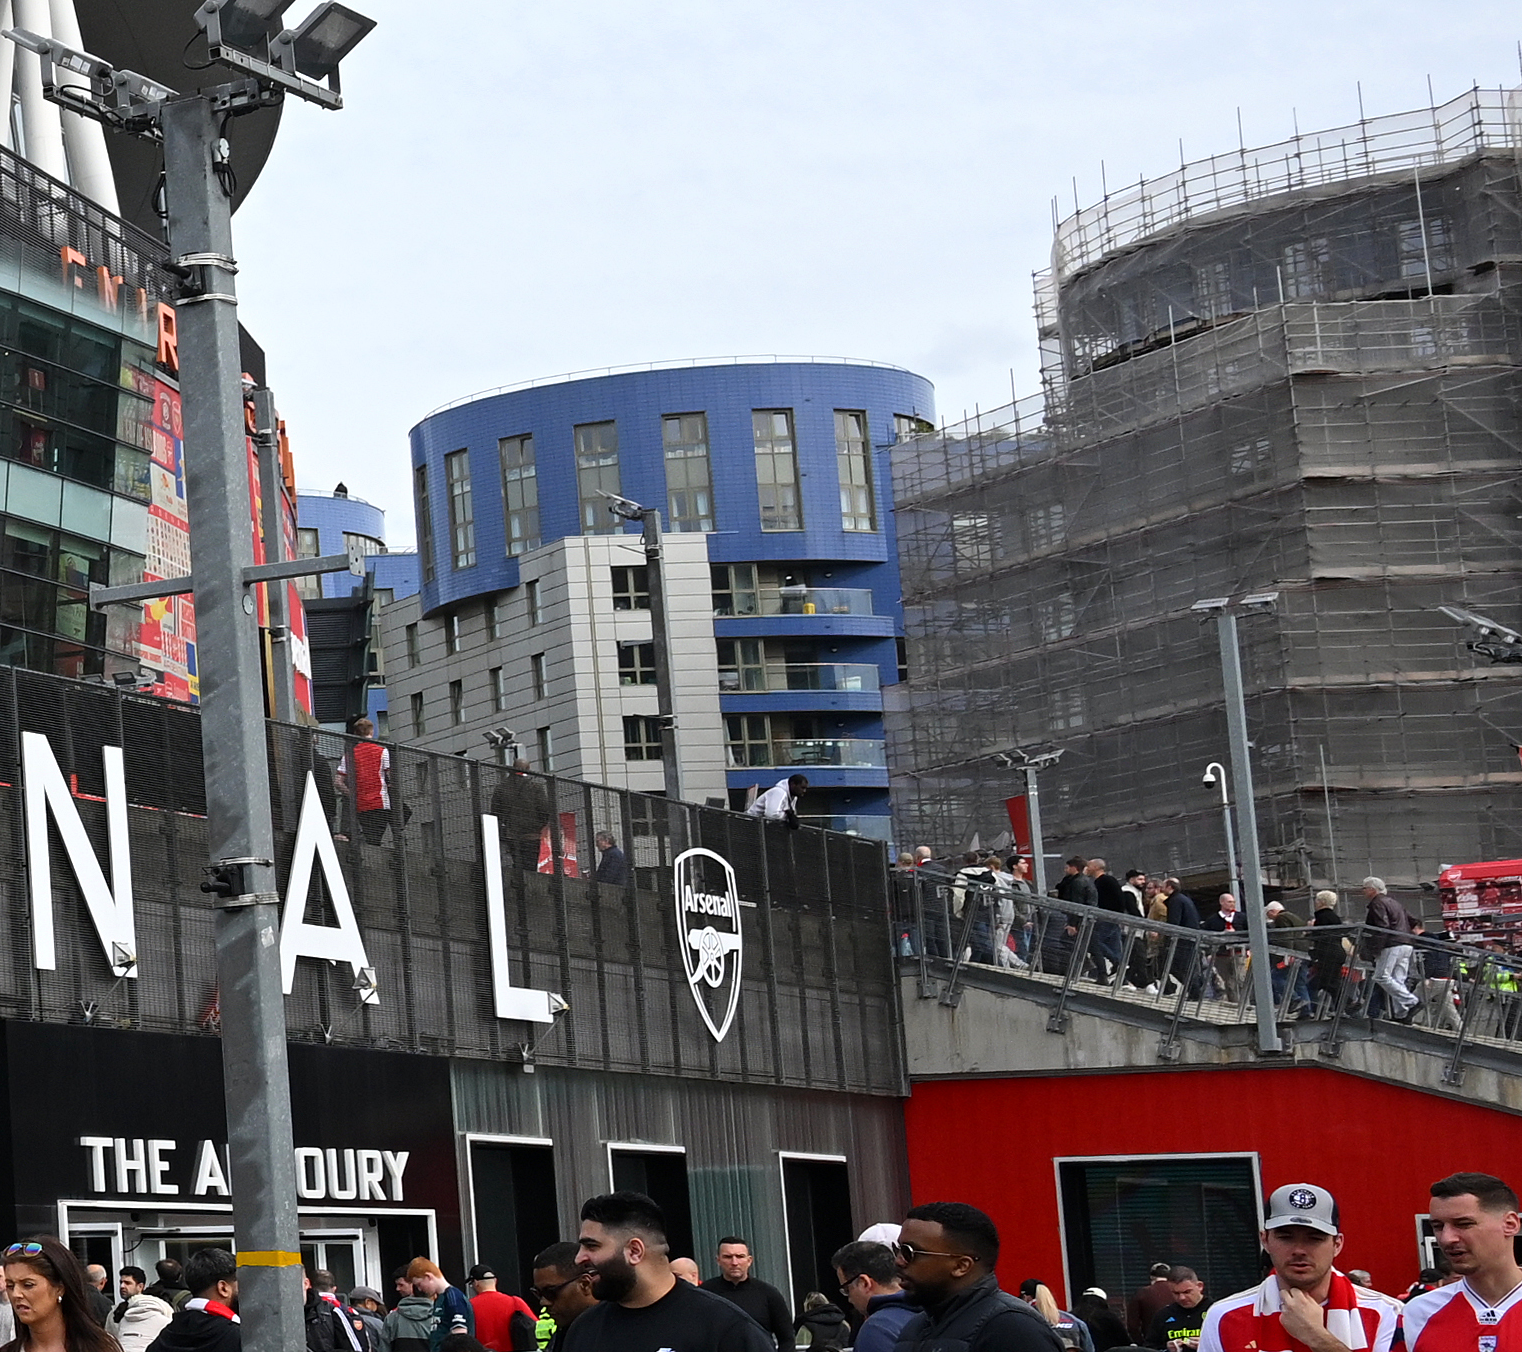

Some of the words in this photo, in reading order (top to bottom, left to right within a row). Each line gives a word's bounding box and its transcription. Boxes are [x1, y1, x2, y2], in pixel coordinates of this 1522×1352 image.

[682, 882, 732, 919] Arsenal
[80, 1136, 179, 1195] THE
[193, 1139, 410, 1202] AOURY
[1167, 1328, 1201, 1339] Emira
